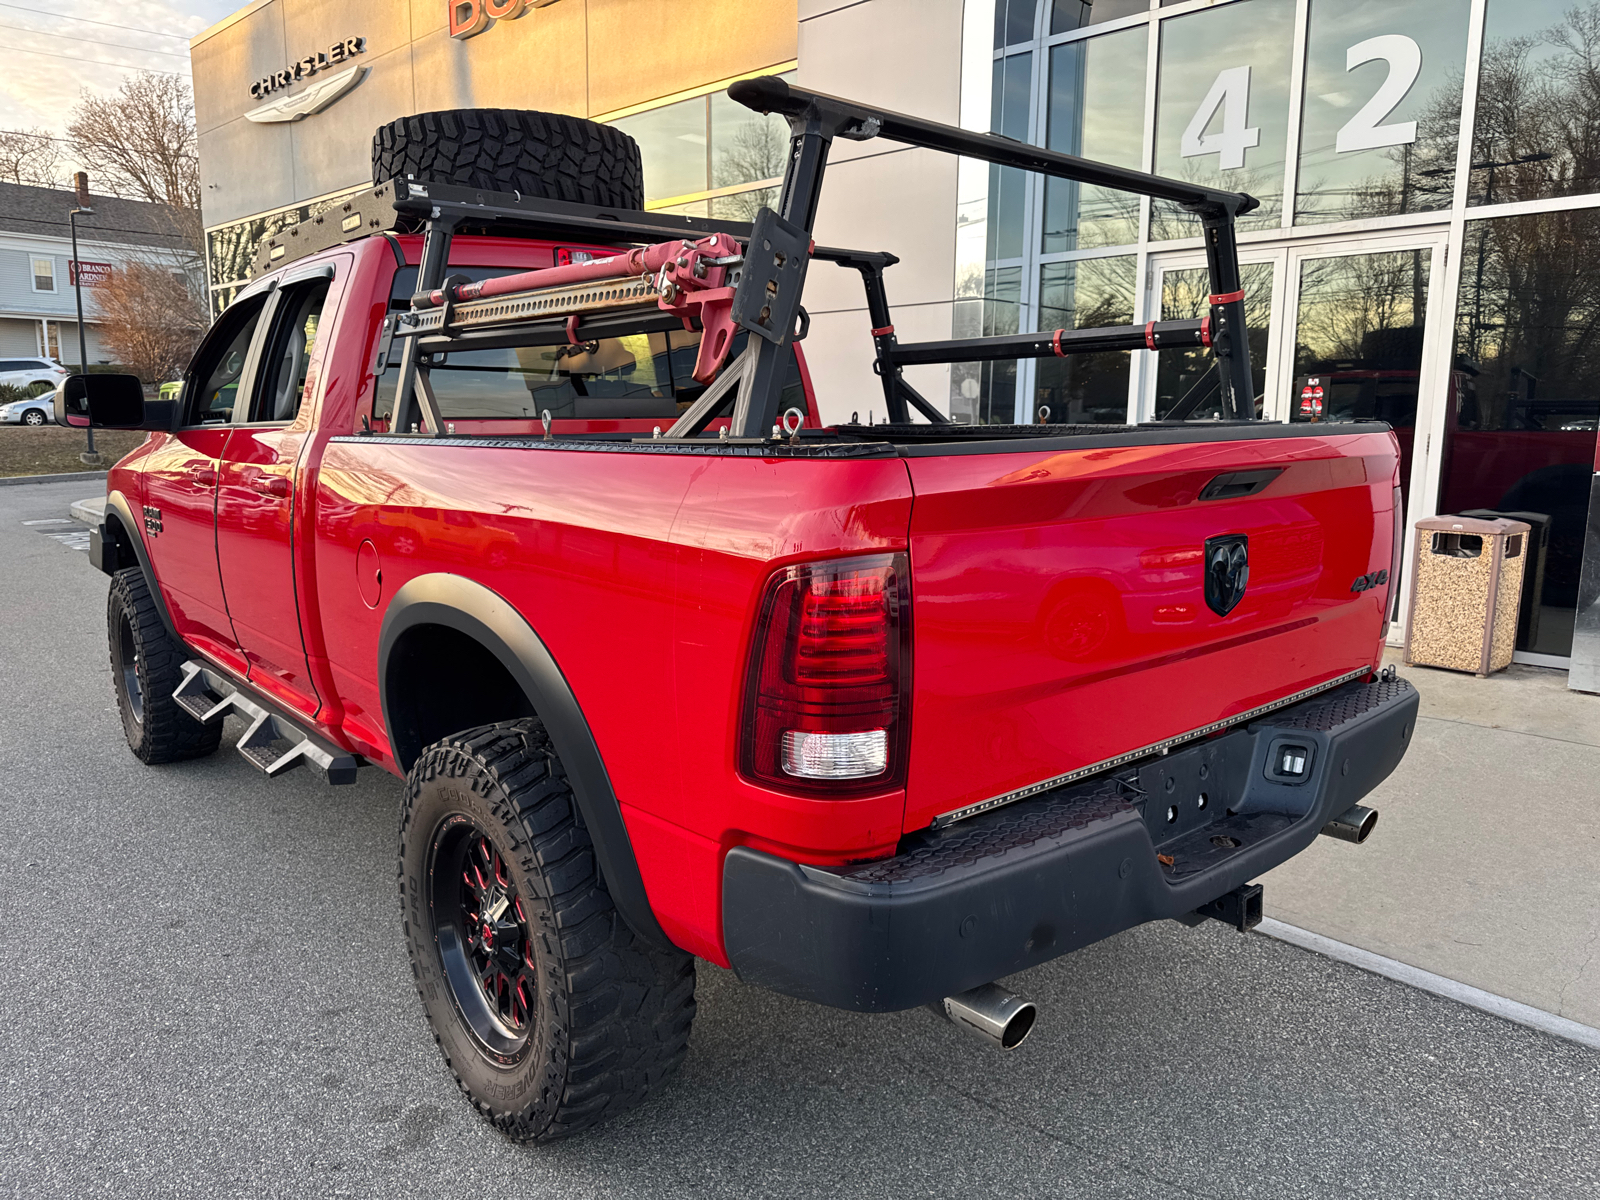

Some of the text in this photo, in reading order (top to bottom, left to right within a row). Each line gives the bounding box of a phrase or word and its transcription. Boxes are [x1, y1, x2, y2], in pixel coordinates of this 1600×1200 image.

[248, 36, 364, 100] CHRYSLER
[82, 264, 111, 273] BRANCO
[449, 815, 467, 826] FUEL
[410, 875, 439, 1001] STT PRO
